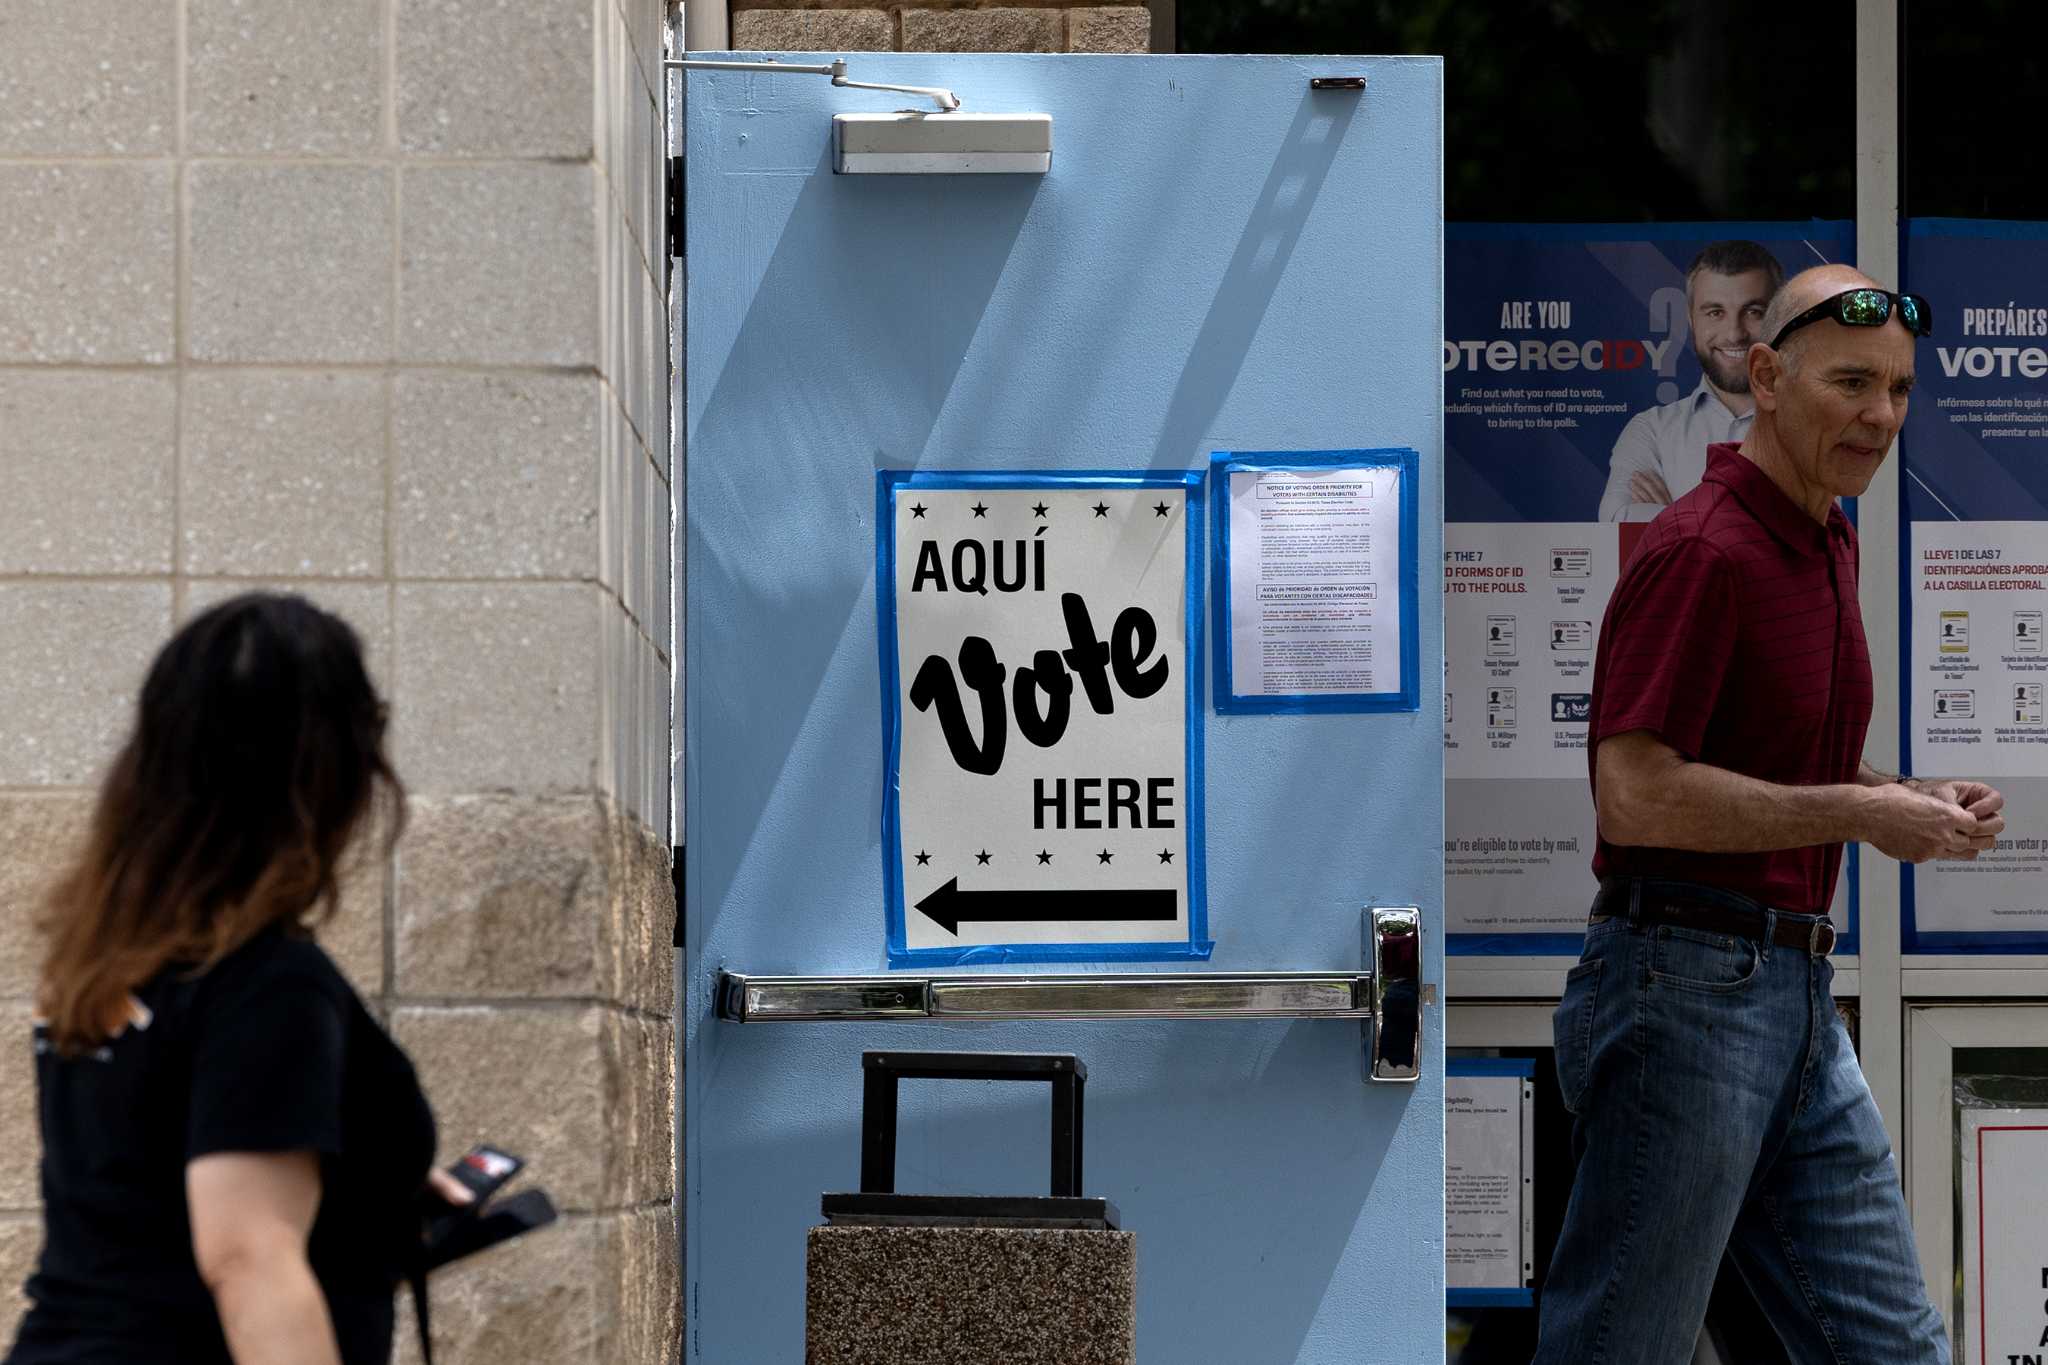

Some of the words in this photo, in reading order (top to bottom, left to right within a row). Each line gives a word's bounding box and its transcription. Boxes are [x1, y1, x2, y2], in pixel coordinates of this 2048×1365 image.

[1500, 301, 1532, 329] ARE
[1538, 301, 1571, 329] YOU
[1963, 301, 2047, 336] PREPÁRES
[1461, 388, 1482, 398] Find
[1483, 389, 1499, 398] out
[1501, 388, 1525, 398] what
[1526, 390, 1543, 400] you
[1544, 388, 1567, 398] need
[1569, 389, 1579, 398] to
[1581, 389, 1604, 399] vote,
[1484, 403, 1511, 413] which
[1513, 403, 1541, 413] forms
[1543, 403, 1553, 413] of
[1556, 403, 1565, 413] ID
[1567, 405, 1582, 413] are
[1583, 403, 1627, 415] approved
[1937, 397, 1985, 408] Infórmese
[1986, 397, 2012, 408] sobre
[2014, 397, 2023, 408] lo
[2024, 397, 2041, 409] qué
[1950, 413, 1967, 422] son
[1968, 411, 1982, 422] las
[1488, 418, 1497, 428] to
[1499, 418, 1523, 429] bring
[1525, 418, 1534, 428] to
[1536, 418, 1552, 428] the
[1554, 418, 1578, 429] polls.
[1982, 428, 2026, 438] presentar
[2028, 429, 2040, 437] en
[911, 524, 1048, 597] AQUÍ
[1454, 551, 1475, 561] THE
[1477, 551, 1483, 561] 7
[1924, 550, 1953, 560] LLEVE
[1955, 550, 1959, 560] 1
[1961, 550, 1974, 560] DE
[1975, 550, 1994, 560] LAS
[1995, 550, 2001, 560] 7
[1455, 567, 1494, 577] FORMS
[1495, 567, 1511, 577] OF
[1512, 567, 1523, 577] ID
[1452, 583, 1466, 593] TO
[1468, 583, 1489, 593] THE
[1491, 583, 1528, 593] POLLS.
[1924, 581, 1931, 591] A
[1933, 581, 1945, 591] LA
[1946, 581, 1986, 591] CASILLA
[1988, 581, 2046, 591] ELECTORAL.
[909, 592, 1170, 776] Vote
[1034, 777, 1176, 829] HERE
[1471, 838, 1506, 854] eligible
[1509, 839, 1518, 851] to
[1520, 839, 1541, 851] vote
[1543, 838, 1554, 854] by
[1556, 838, 1580, 854] mail,
[2015, 838, 2039, 850] votar
